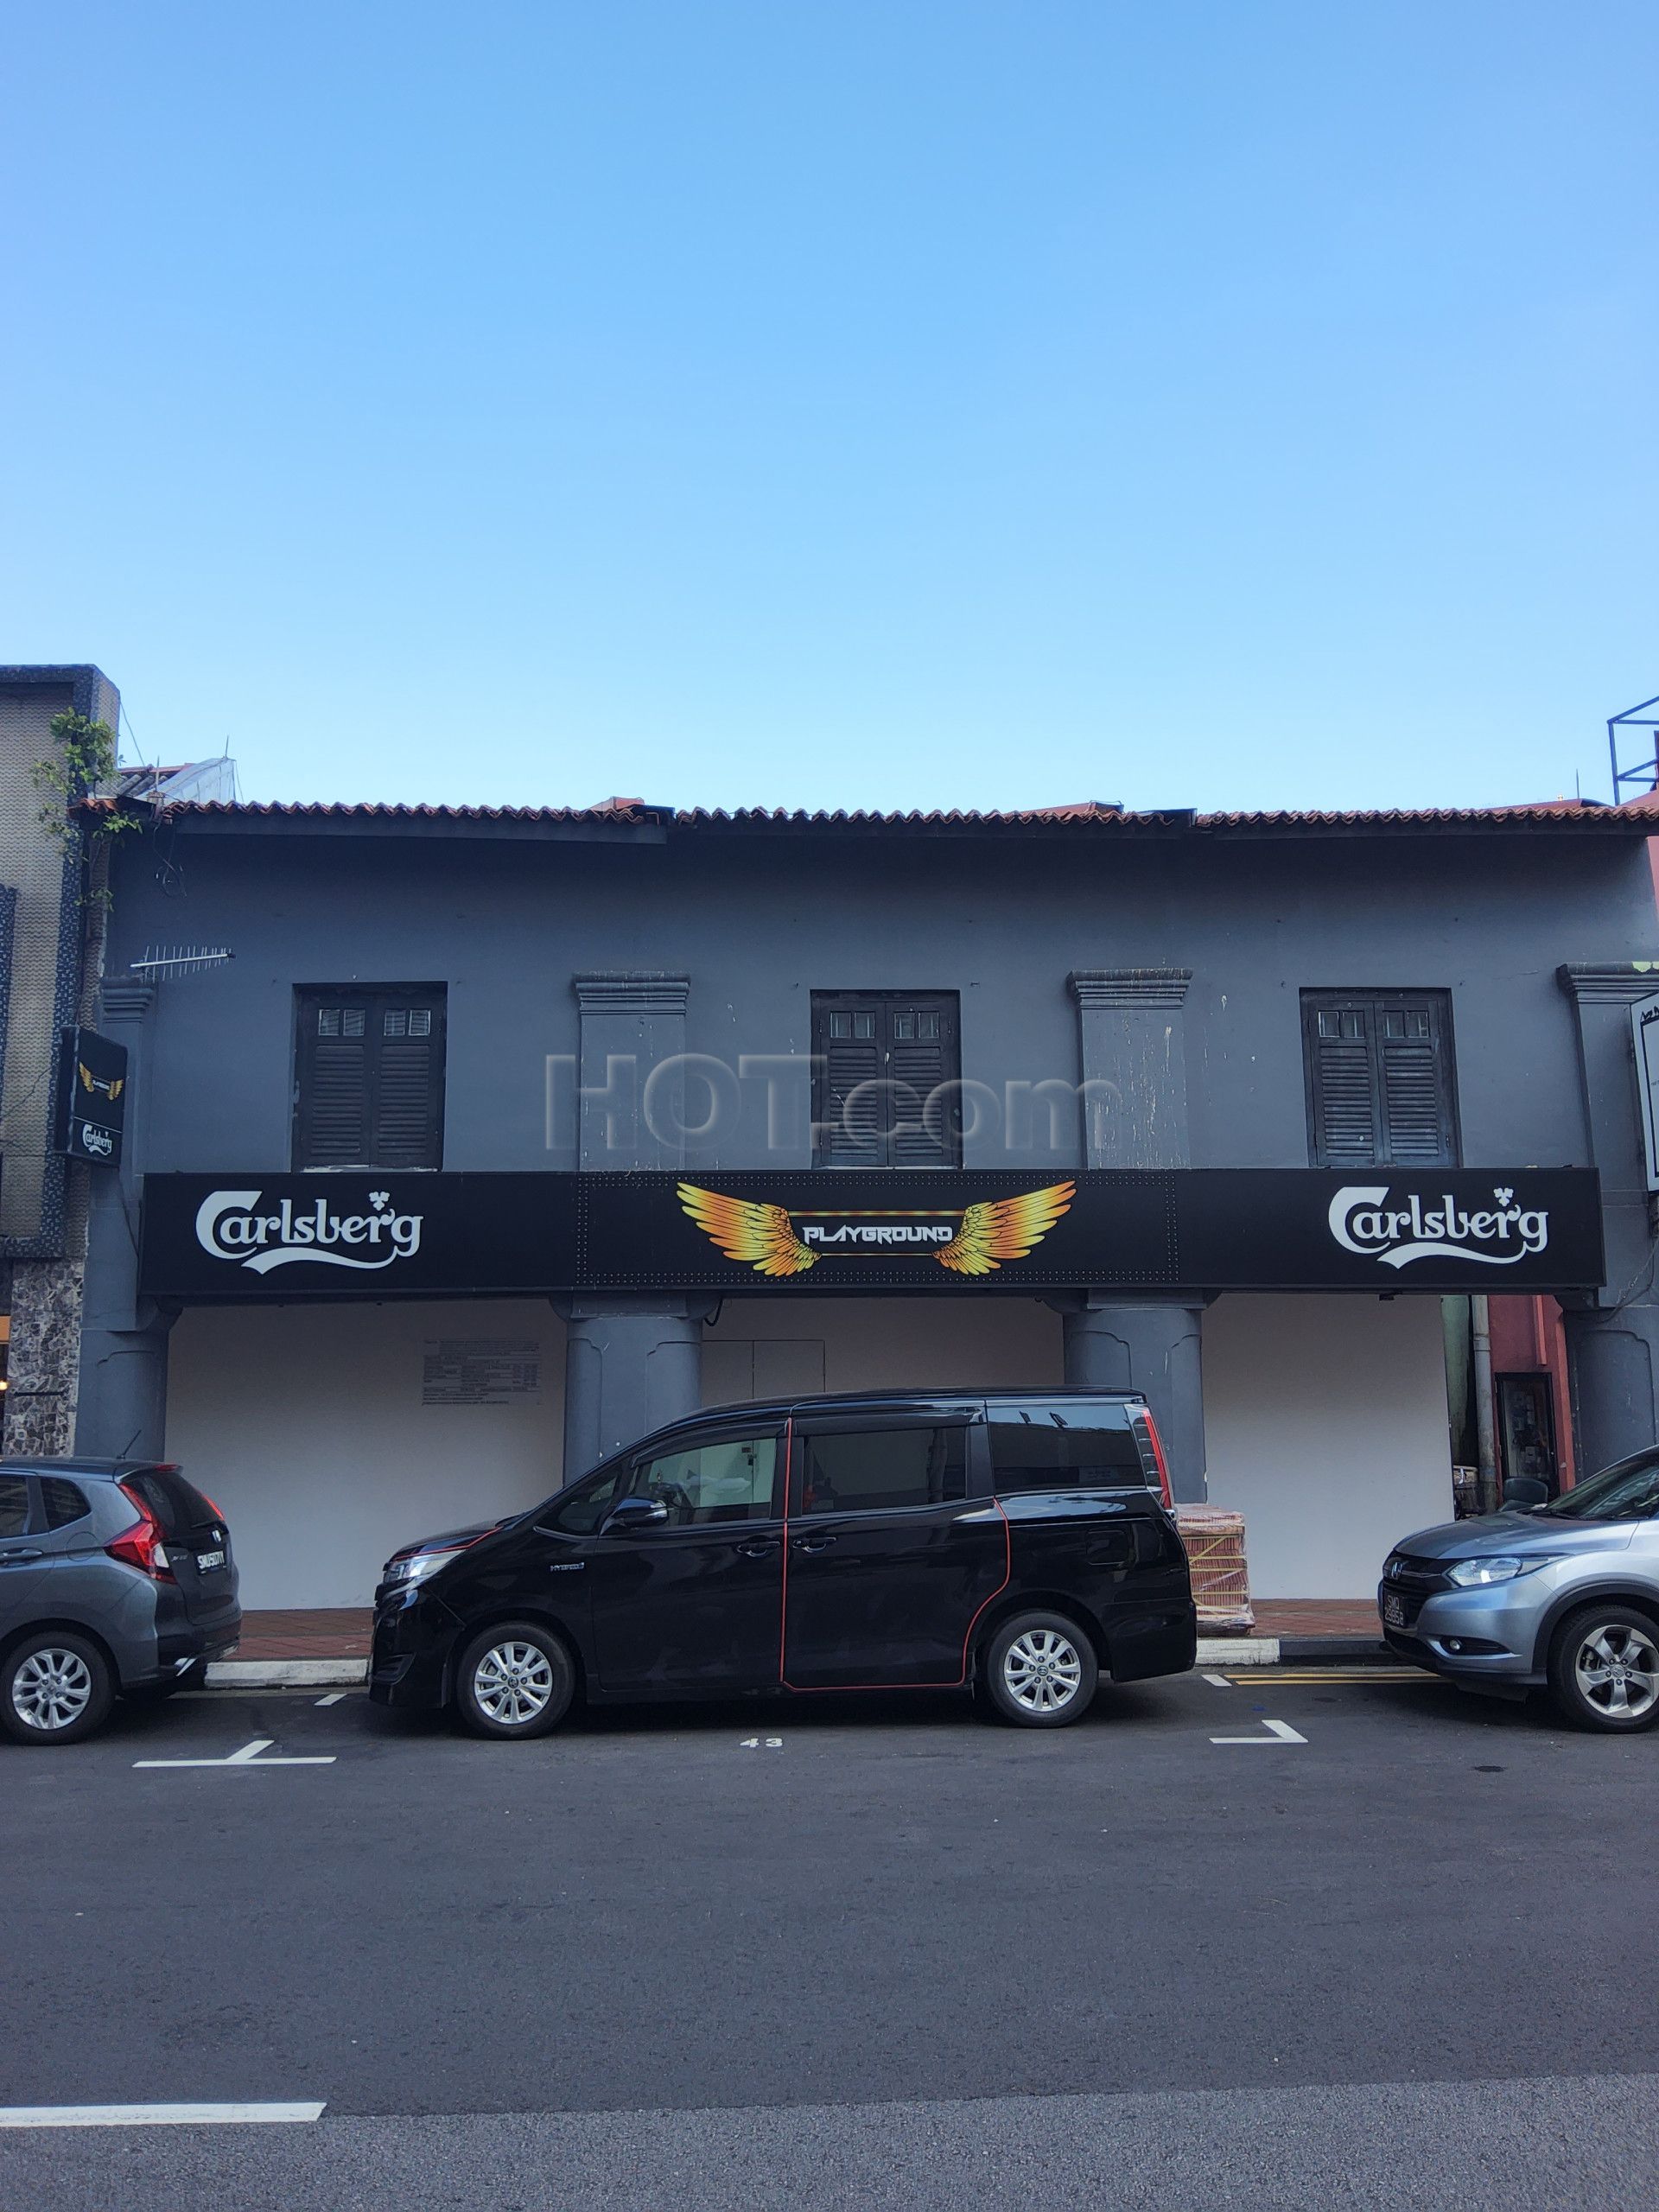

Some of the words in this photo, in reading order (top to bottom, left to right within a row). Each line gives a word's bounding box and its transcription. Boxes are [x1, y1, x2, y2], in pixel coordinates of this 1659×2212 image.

[82, 1123, 112, 1155] Carlsberg
[195, 1190, 423, 1274] Carlsberg
[802, 1224, 953, 1245] PLAYGROUND
[1328, 1186, 1548, 1269] Carlsberg
[740, 1738, 783, 1748] 43
